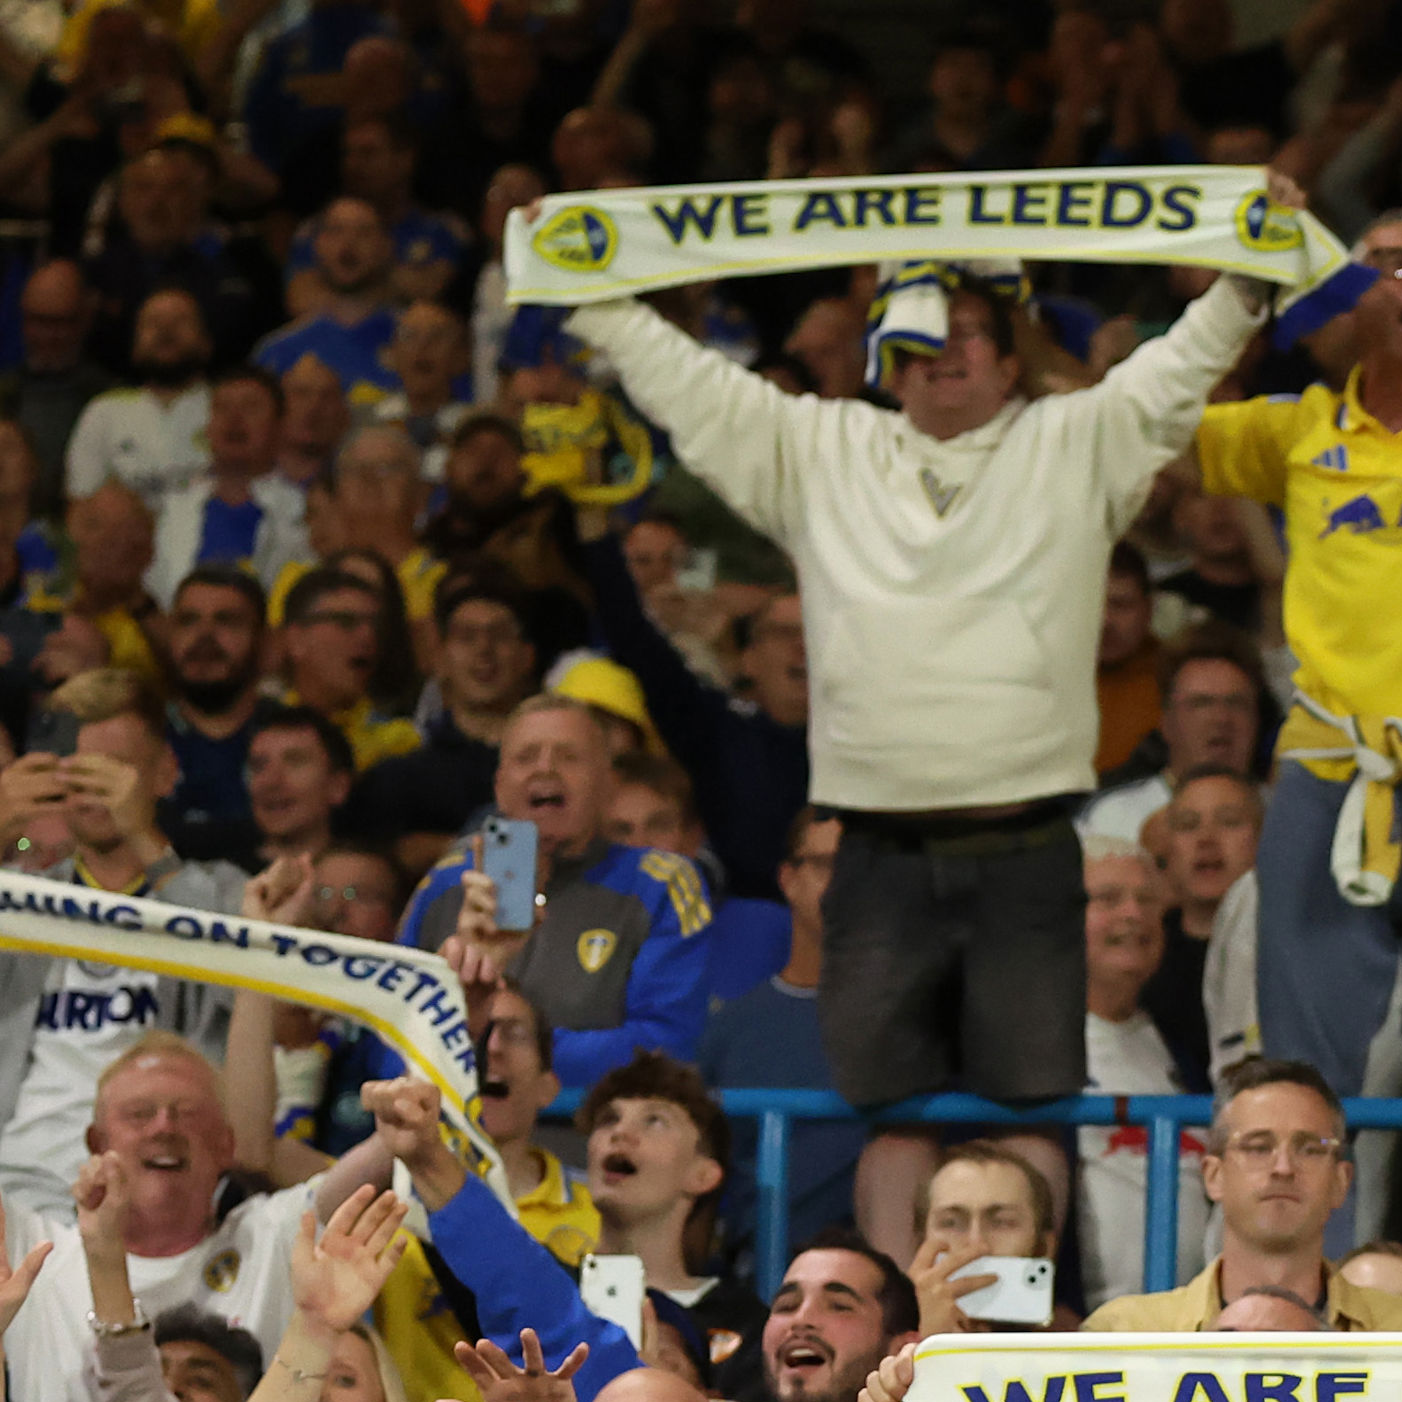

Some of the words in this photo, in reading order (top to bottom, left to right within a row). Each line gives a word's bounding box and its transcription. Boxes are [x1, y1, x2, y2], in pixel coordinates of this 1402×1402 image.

[654, 193, 772, 246] WE
[794, 184, 942, 232] ARE
[966, 181, 1202, 232] LEEDS
[165, 915, 249, 949] ON
